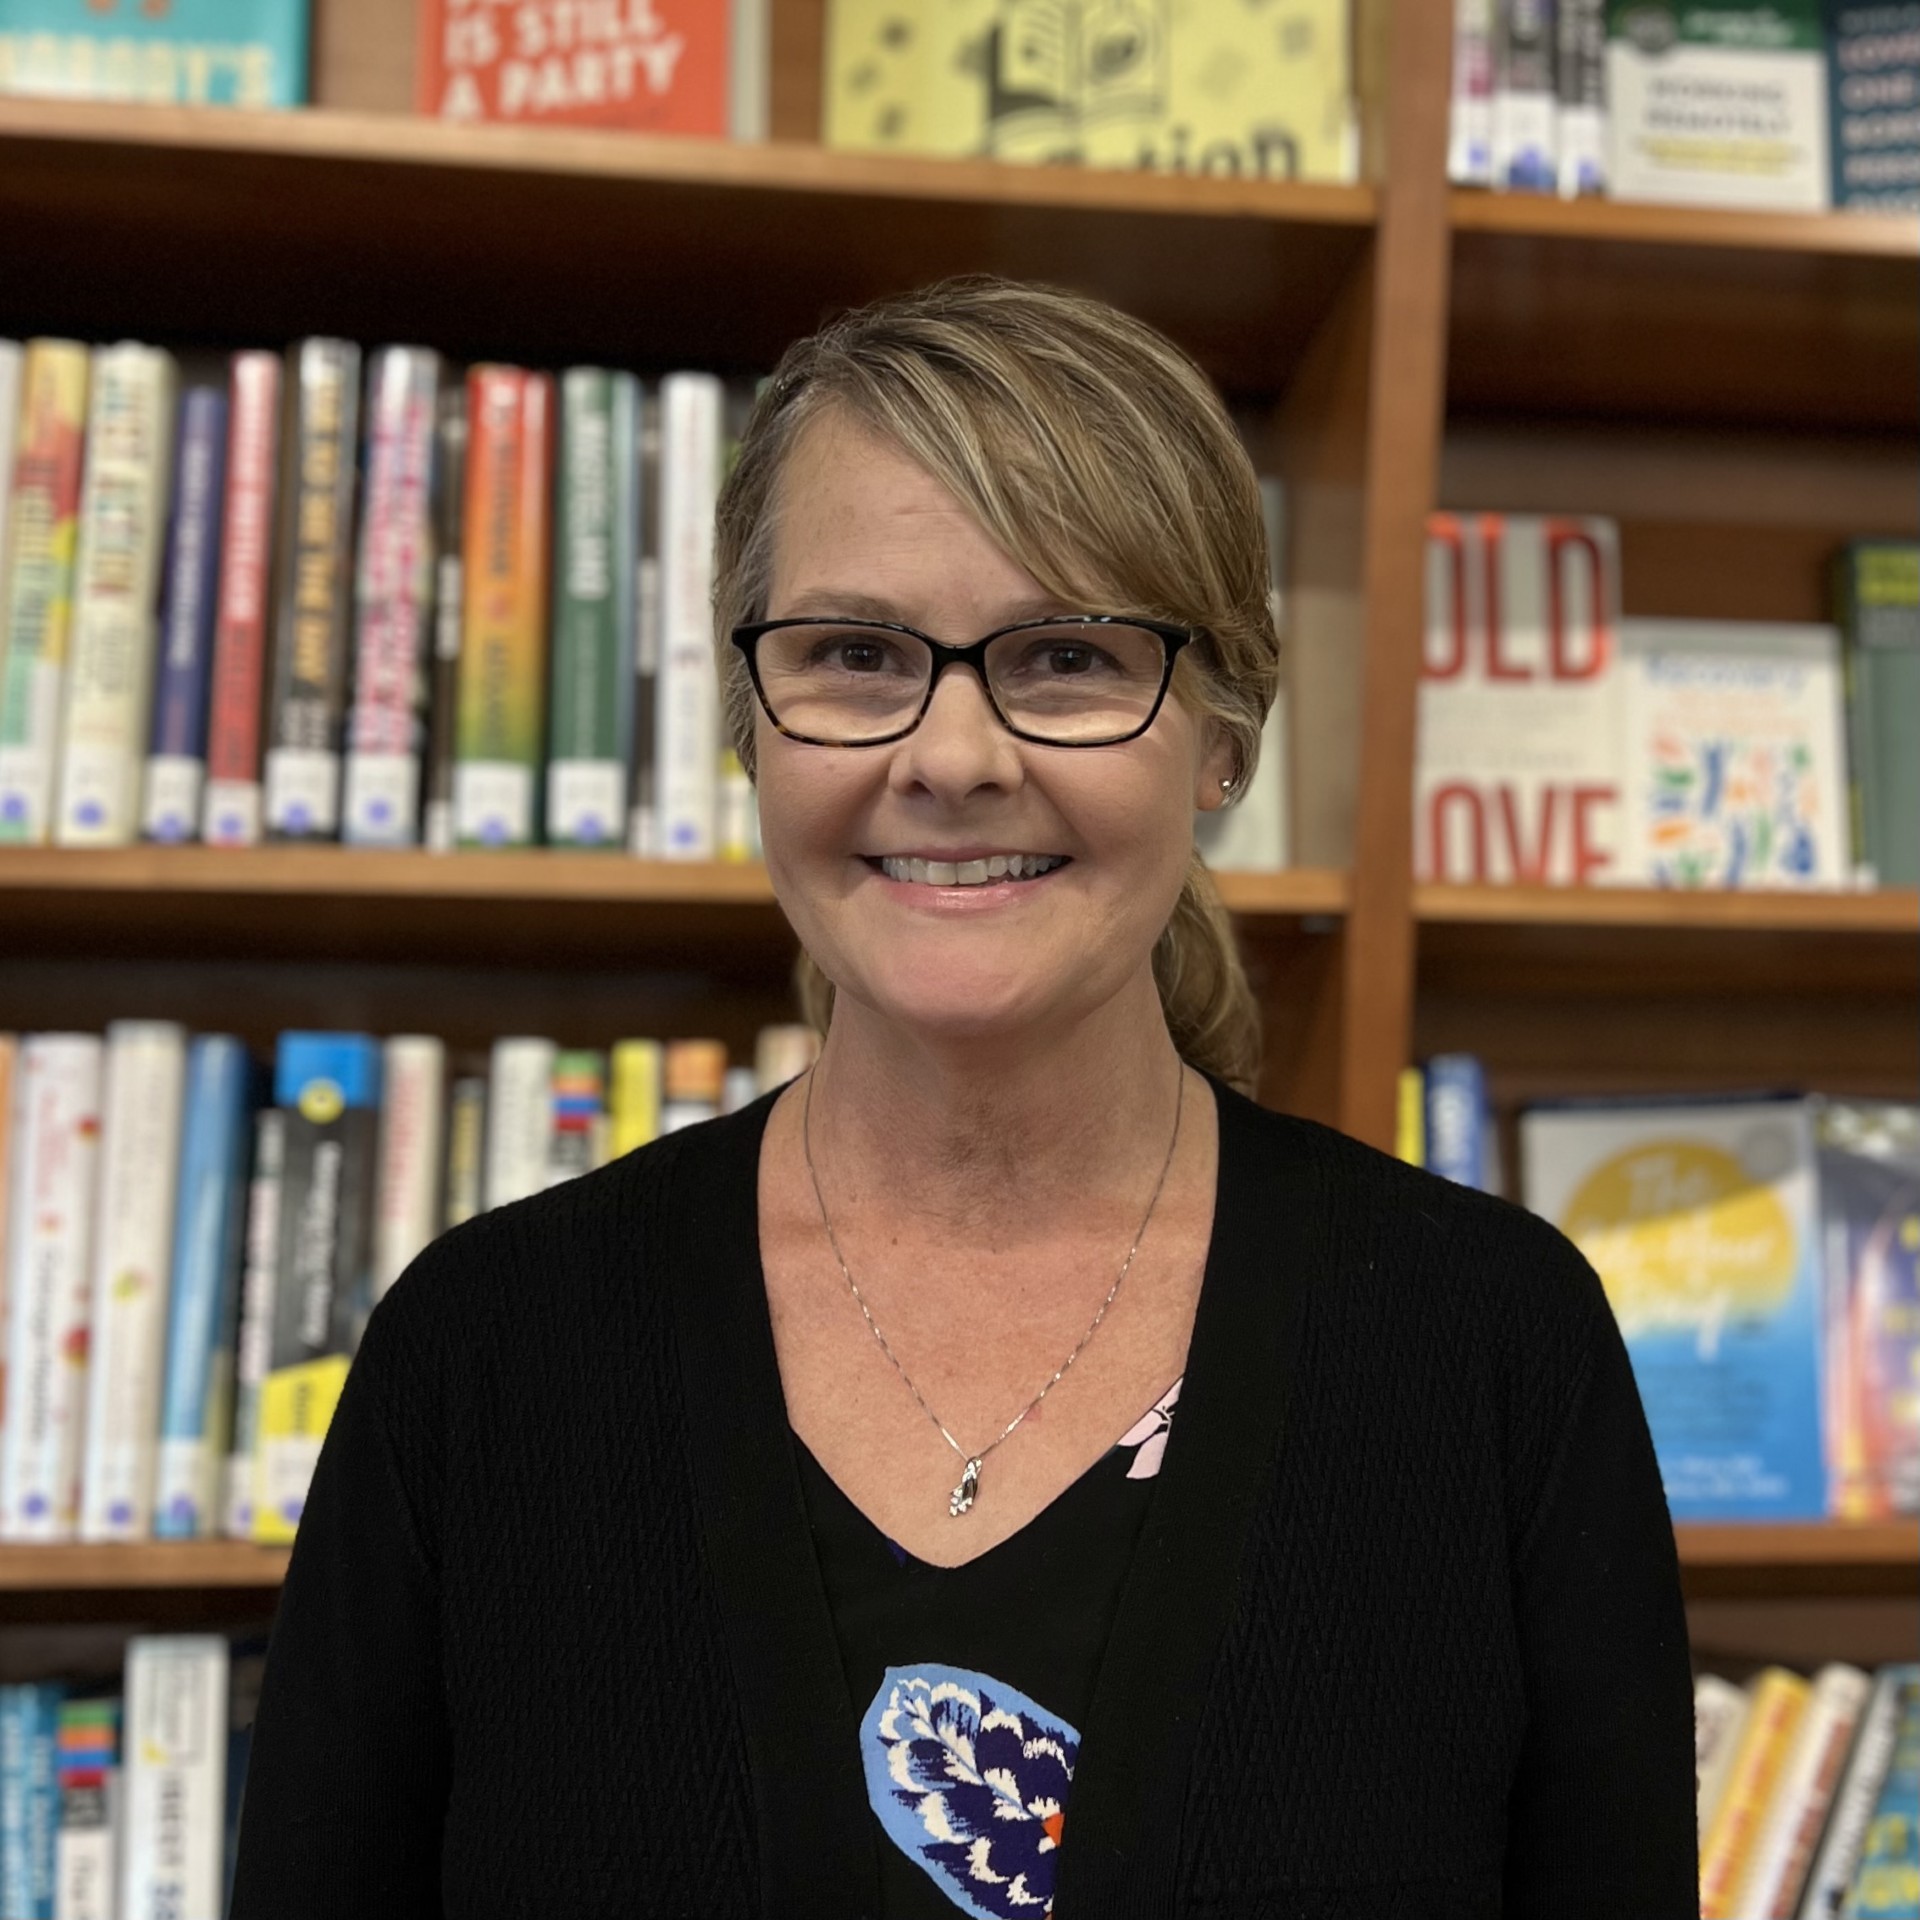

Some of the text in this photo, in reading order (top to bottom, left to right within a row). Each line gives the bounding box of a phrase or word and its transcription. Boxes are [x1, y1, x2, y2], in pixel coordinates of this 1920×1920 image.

[444, 0, 665, 69] IS STILL
[441, 37, 684, 122] A PARTY
